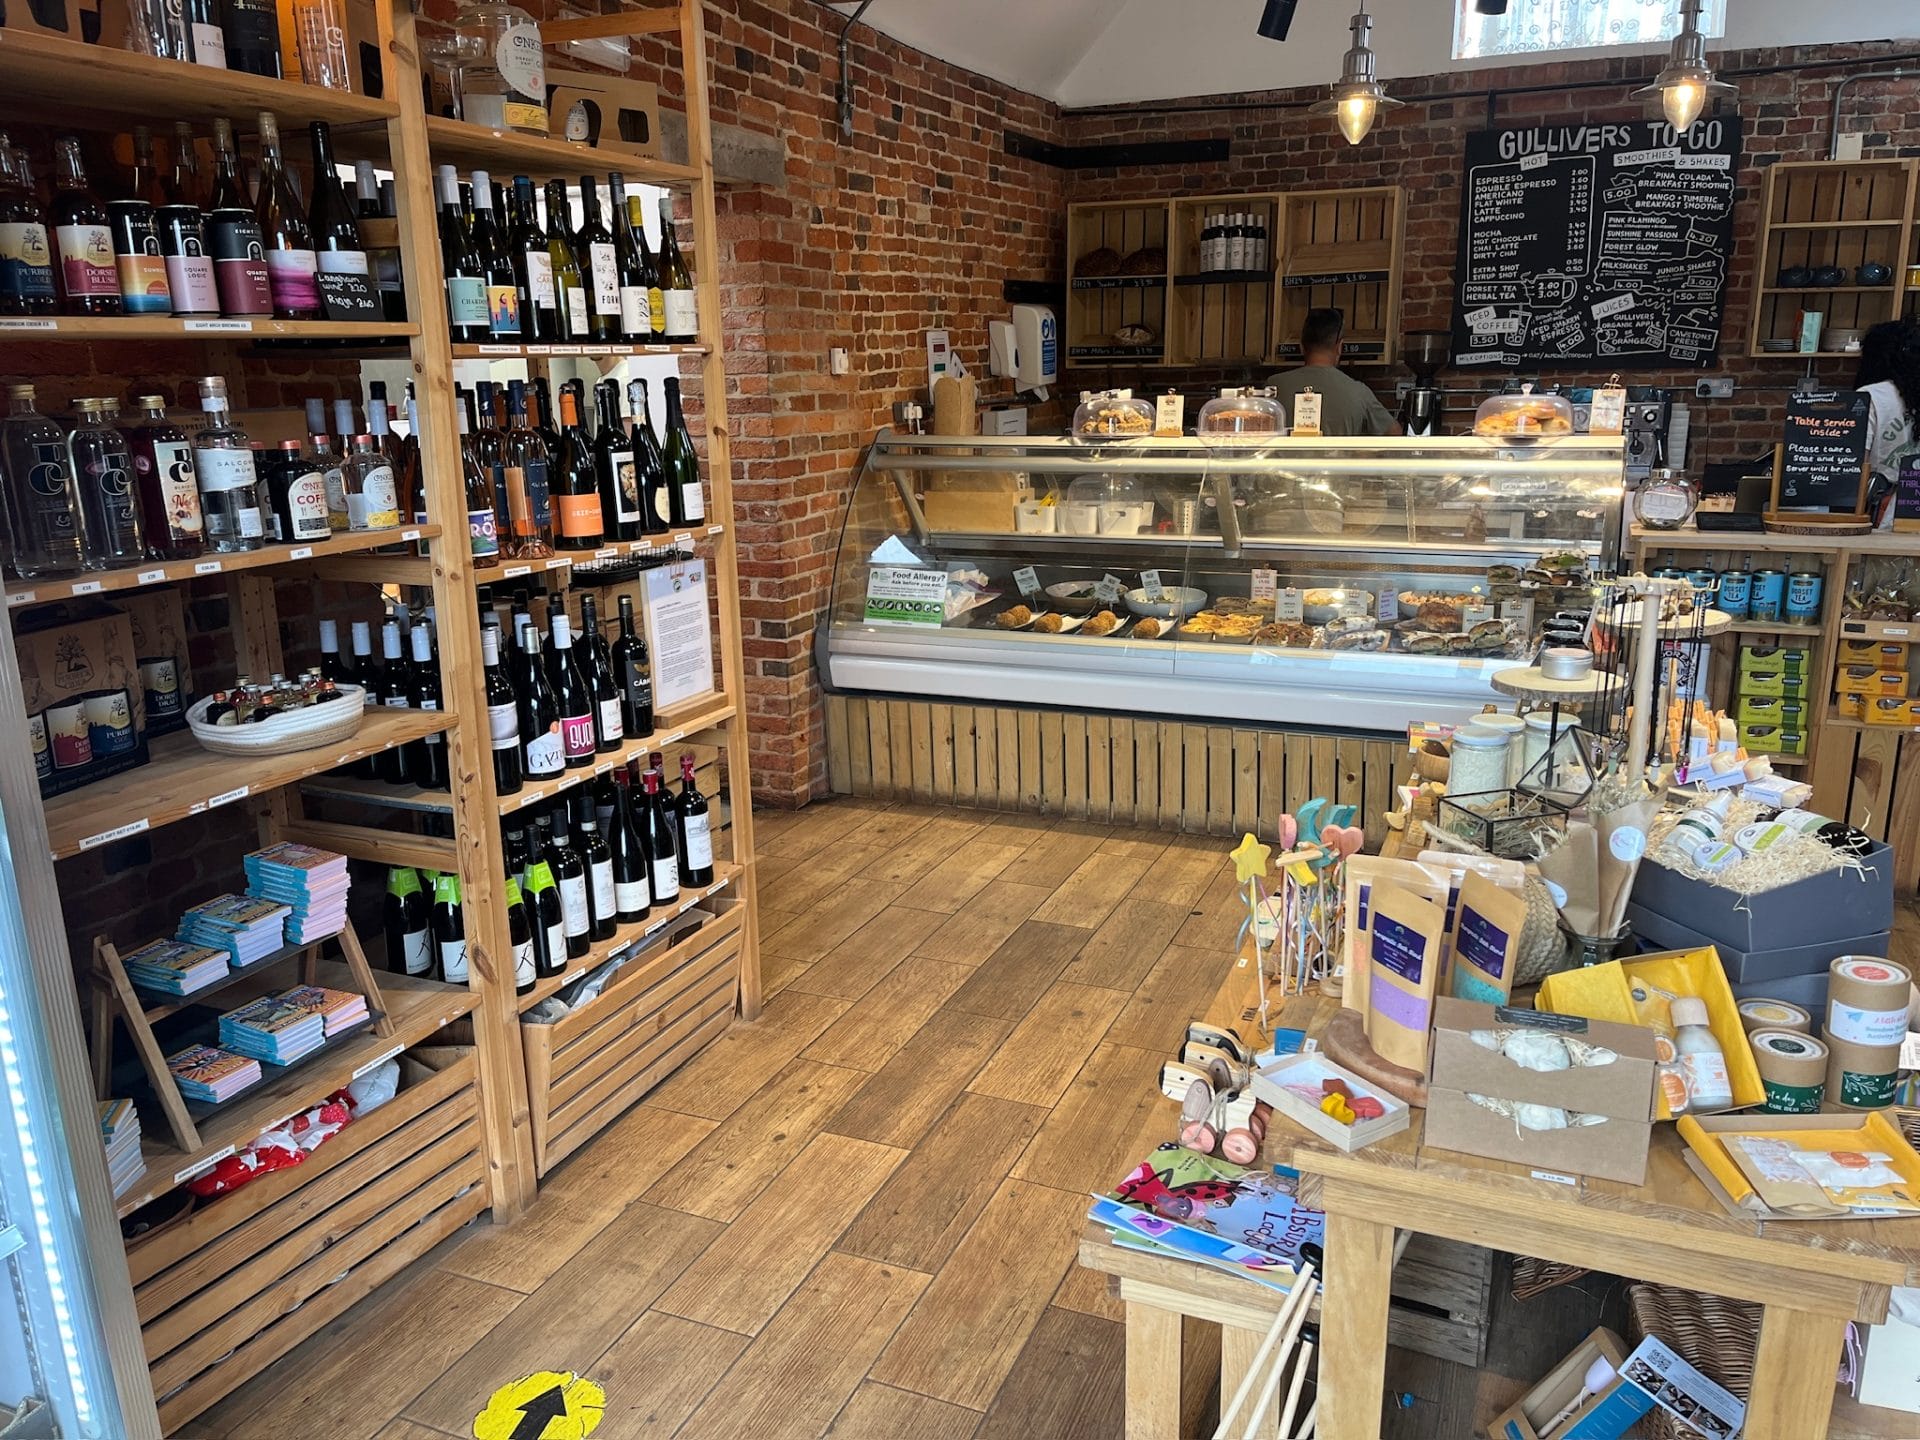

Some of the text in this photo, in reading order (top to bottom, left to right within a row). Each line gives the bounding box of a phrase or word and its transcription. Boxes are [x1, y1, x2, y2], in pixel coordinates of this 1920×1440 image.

[1499, 120, 1722, 160] GULLIVERS TO-GO
[1523, 155, 1544, 167] HOT
[1617, 150, 1675, 164] SMOOTHIES
[1690, 158, 1726, 166] SHAKES
[1476, 174, 1523, 185] ESPRESSO
[1653, 172, 1715, 181] 'PINA COLADA'
[1475, 179, 1557, 193] DOUBLE ESPRESSO
[1638, 180, 1730, 189] BREAKFAST SMOOTHIE
[1475, 190, 1524, 201] AMERICANO
[1607, 188, 1631, 199] 5.00
[1475, 200, 1493, 208] FLAT
[1496, 198, 1524, 206] WHITE
[1683, 195, 1718, 203] TUMERIC
[1683, 202, 1725, 210] SMOOTHIE
[1474, 207, 1501, 216] LATTE
[1474, 212, 1525, 223] CAPPUCCINO
[1474, 230, 1502, 238] MOCHA
[1491, 234, 1538, 244] CHOCOLATE
[1606, 230, 1642, 238] SUNSHINE
[1689, 232, 1713, 243] 4.20
[1495, 242, 1519, 250] LATTE
[1473, 252, 1497, 260] DIRTY
[1473, 266, 1496, 274] EXTRA
[1499, 264, 1520, 272] SHOT
[1601, 262, 1649, 270] MILKSHAKES
[1656, 265, 1685, 275] JUNIOR
[1687, 260, 1717, 271] SHAKES
[17, 268, 52, 277] PURBE
[1473, 273, 1496, 281] SYRUP
[1538, 290, 1560, 299] 3.00
[461, 298, 488, 306] CHARDO
[1596, 297, 1630, 316] JUICES
[1469, 310, 1491, 322] ICED
[1476, 321, 1513, 330] COFFEE
[1531, 324, 1550, 337] ICED
[1552, 314, 1580, 329] SHAKEN
[1540, 322, 1581, 342] ESPRESSO
[1669, 329, 1713, 340] CAWSTONS
[1472, 336, 1494, 344] 3.50
[1560, 335, 1581, 349] 4.00
[1674, 338, 1699, 346] PRESS
[1672, 349, 1694, 357] 2.50
[1788, 443, 1820, 454] Please
[1823, 444, 1843, 453] take
[1816, 455, 1858, 465] and your
[1810, 464, 1828, 472] will
[1830, 464, 1842, 473] be
[1810, 474, 1830, 482] you
[892, 571, 946, 582] Food Allergy?
[1724, 585, 1746, 593] DORSET
[85, 834, 104, 845] BOTTLE
